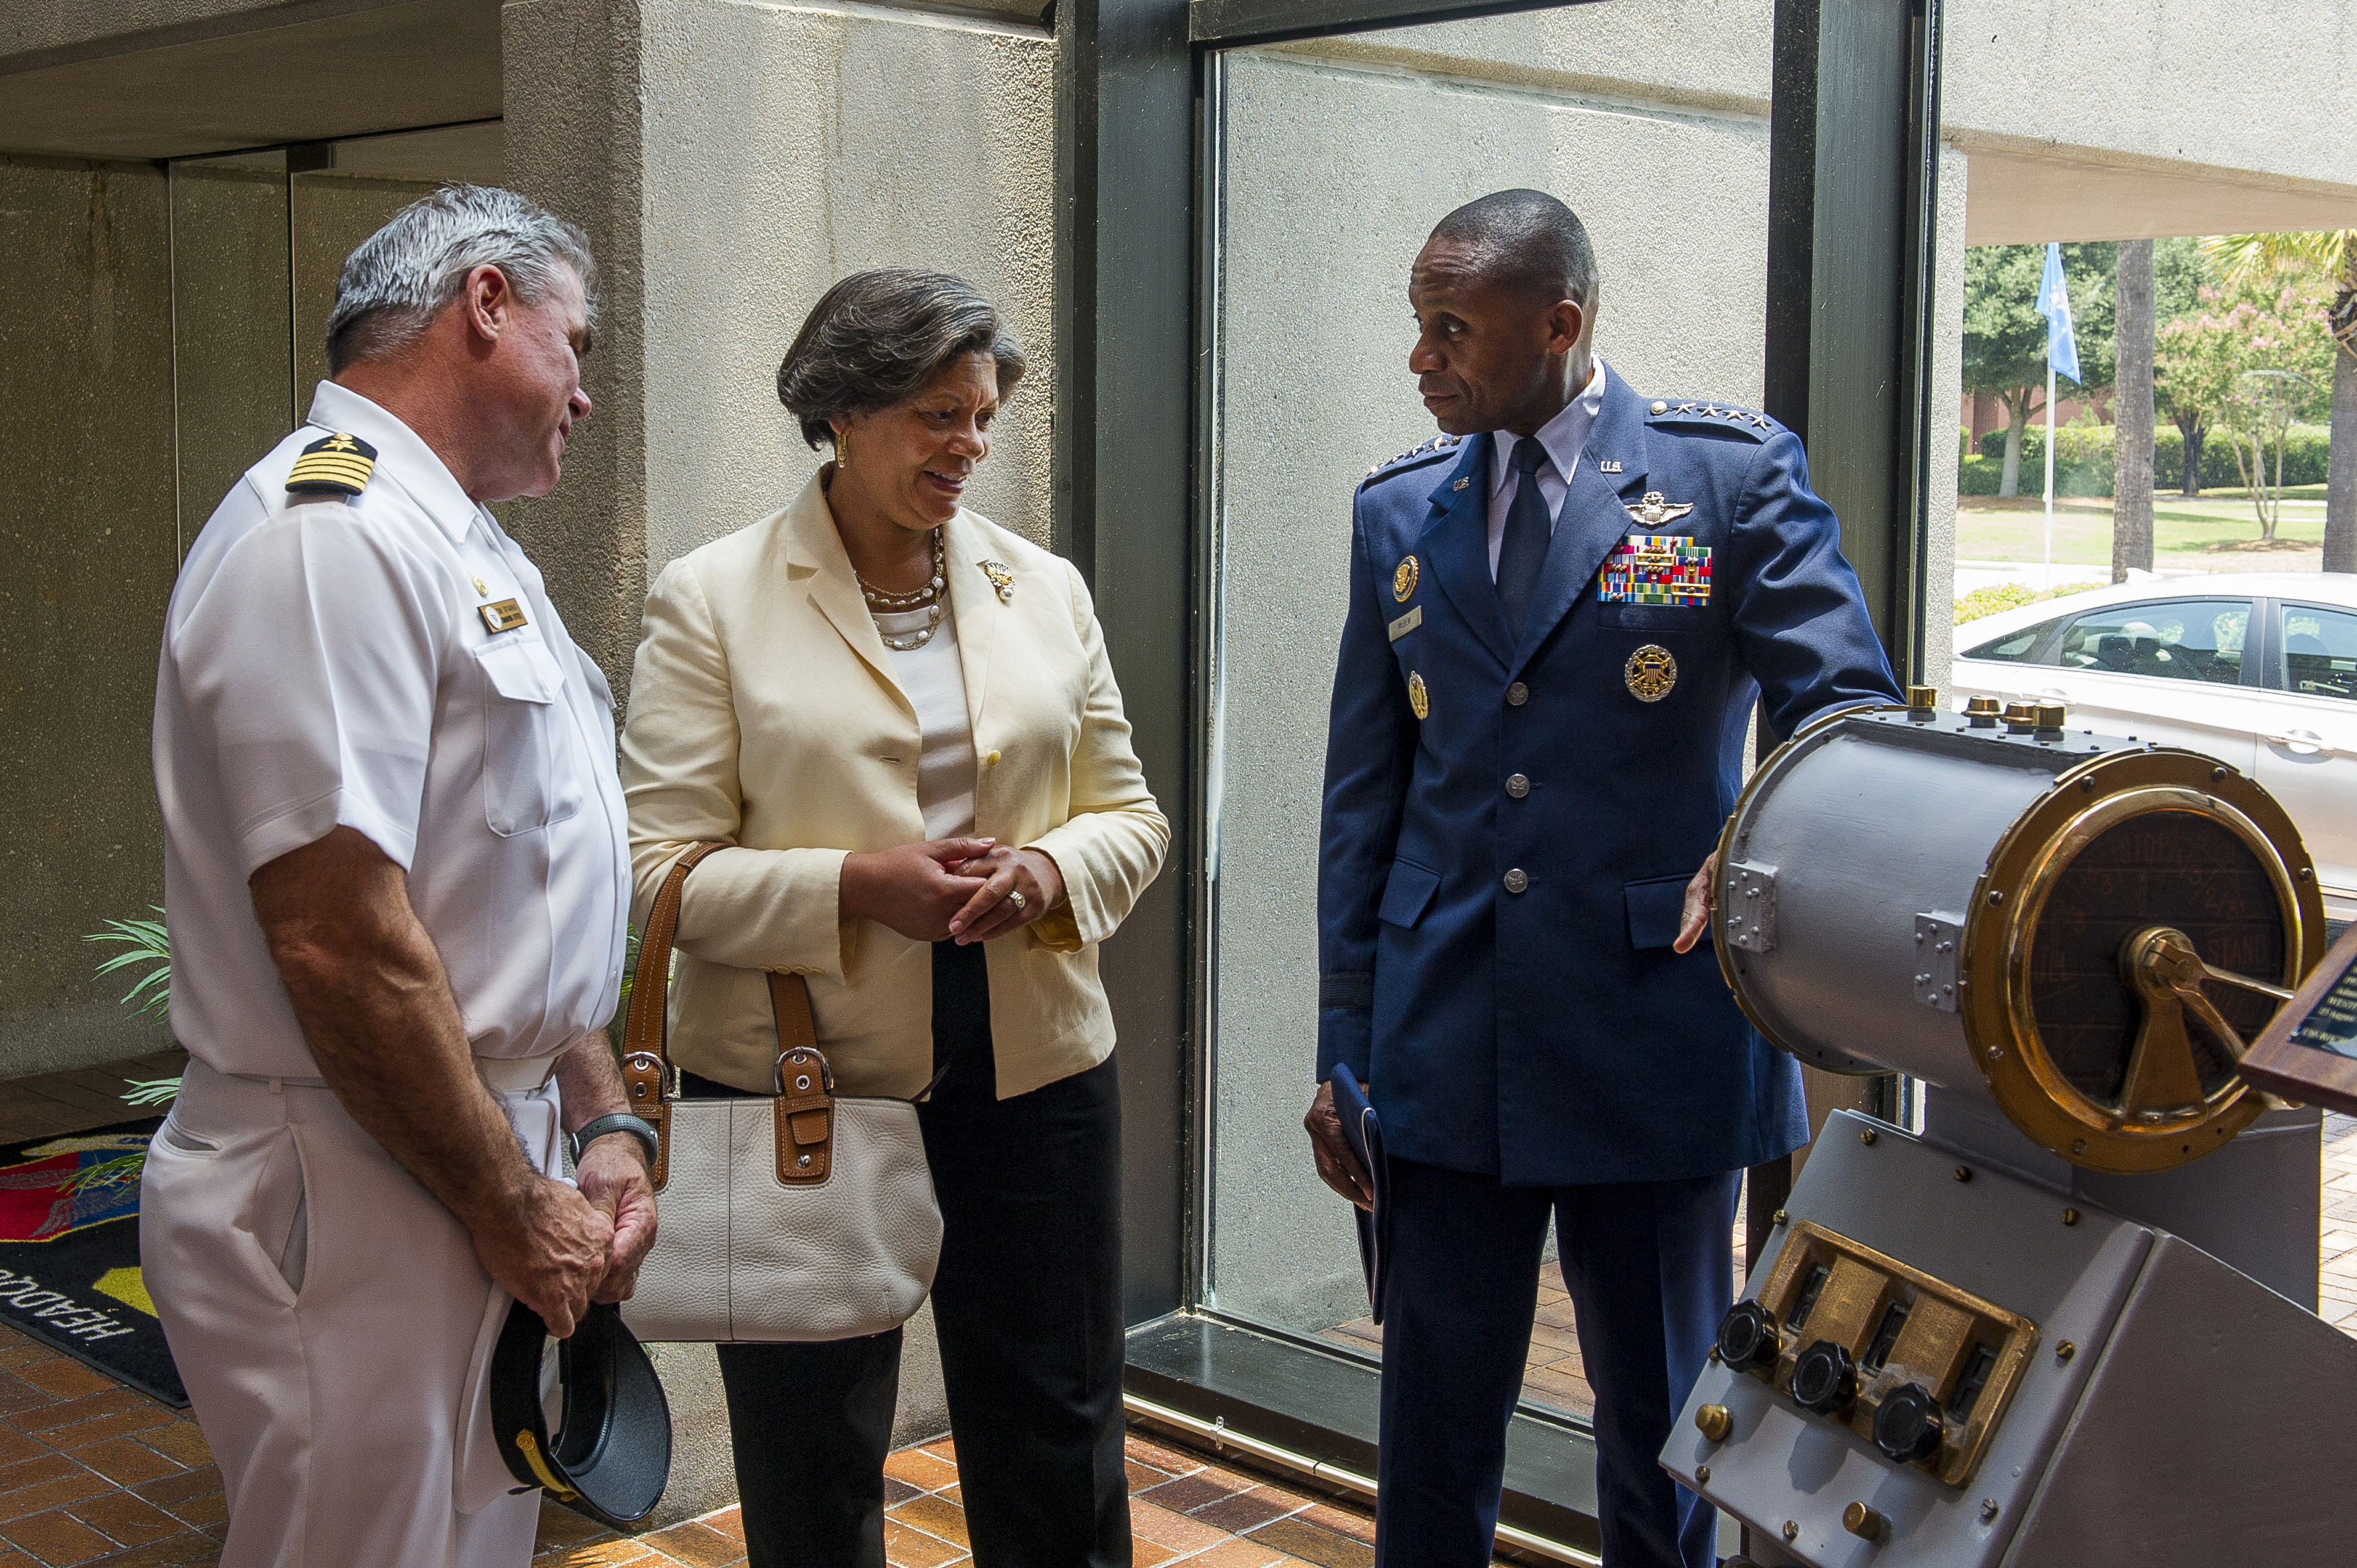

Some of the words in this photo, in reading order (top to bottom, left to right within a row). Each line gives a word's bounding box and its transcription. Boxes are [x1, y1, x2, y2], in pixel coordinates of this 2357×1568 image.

[1600, 461, 1623, 474] U.S.
[2121, 830, 2170, 865] STOP
[2207, 933, 2268, 967] STAND
[0, 1269, 136, 1341] HEADQ
